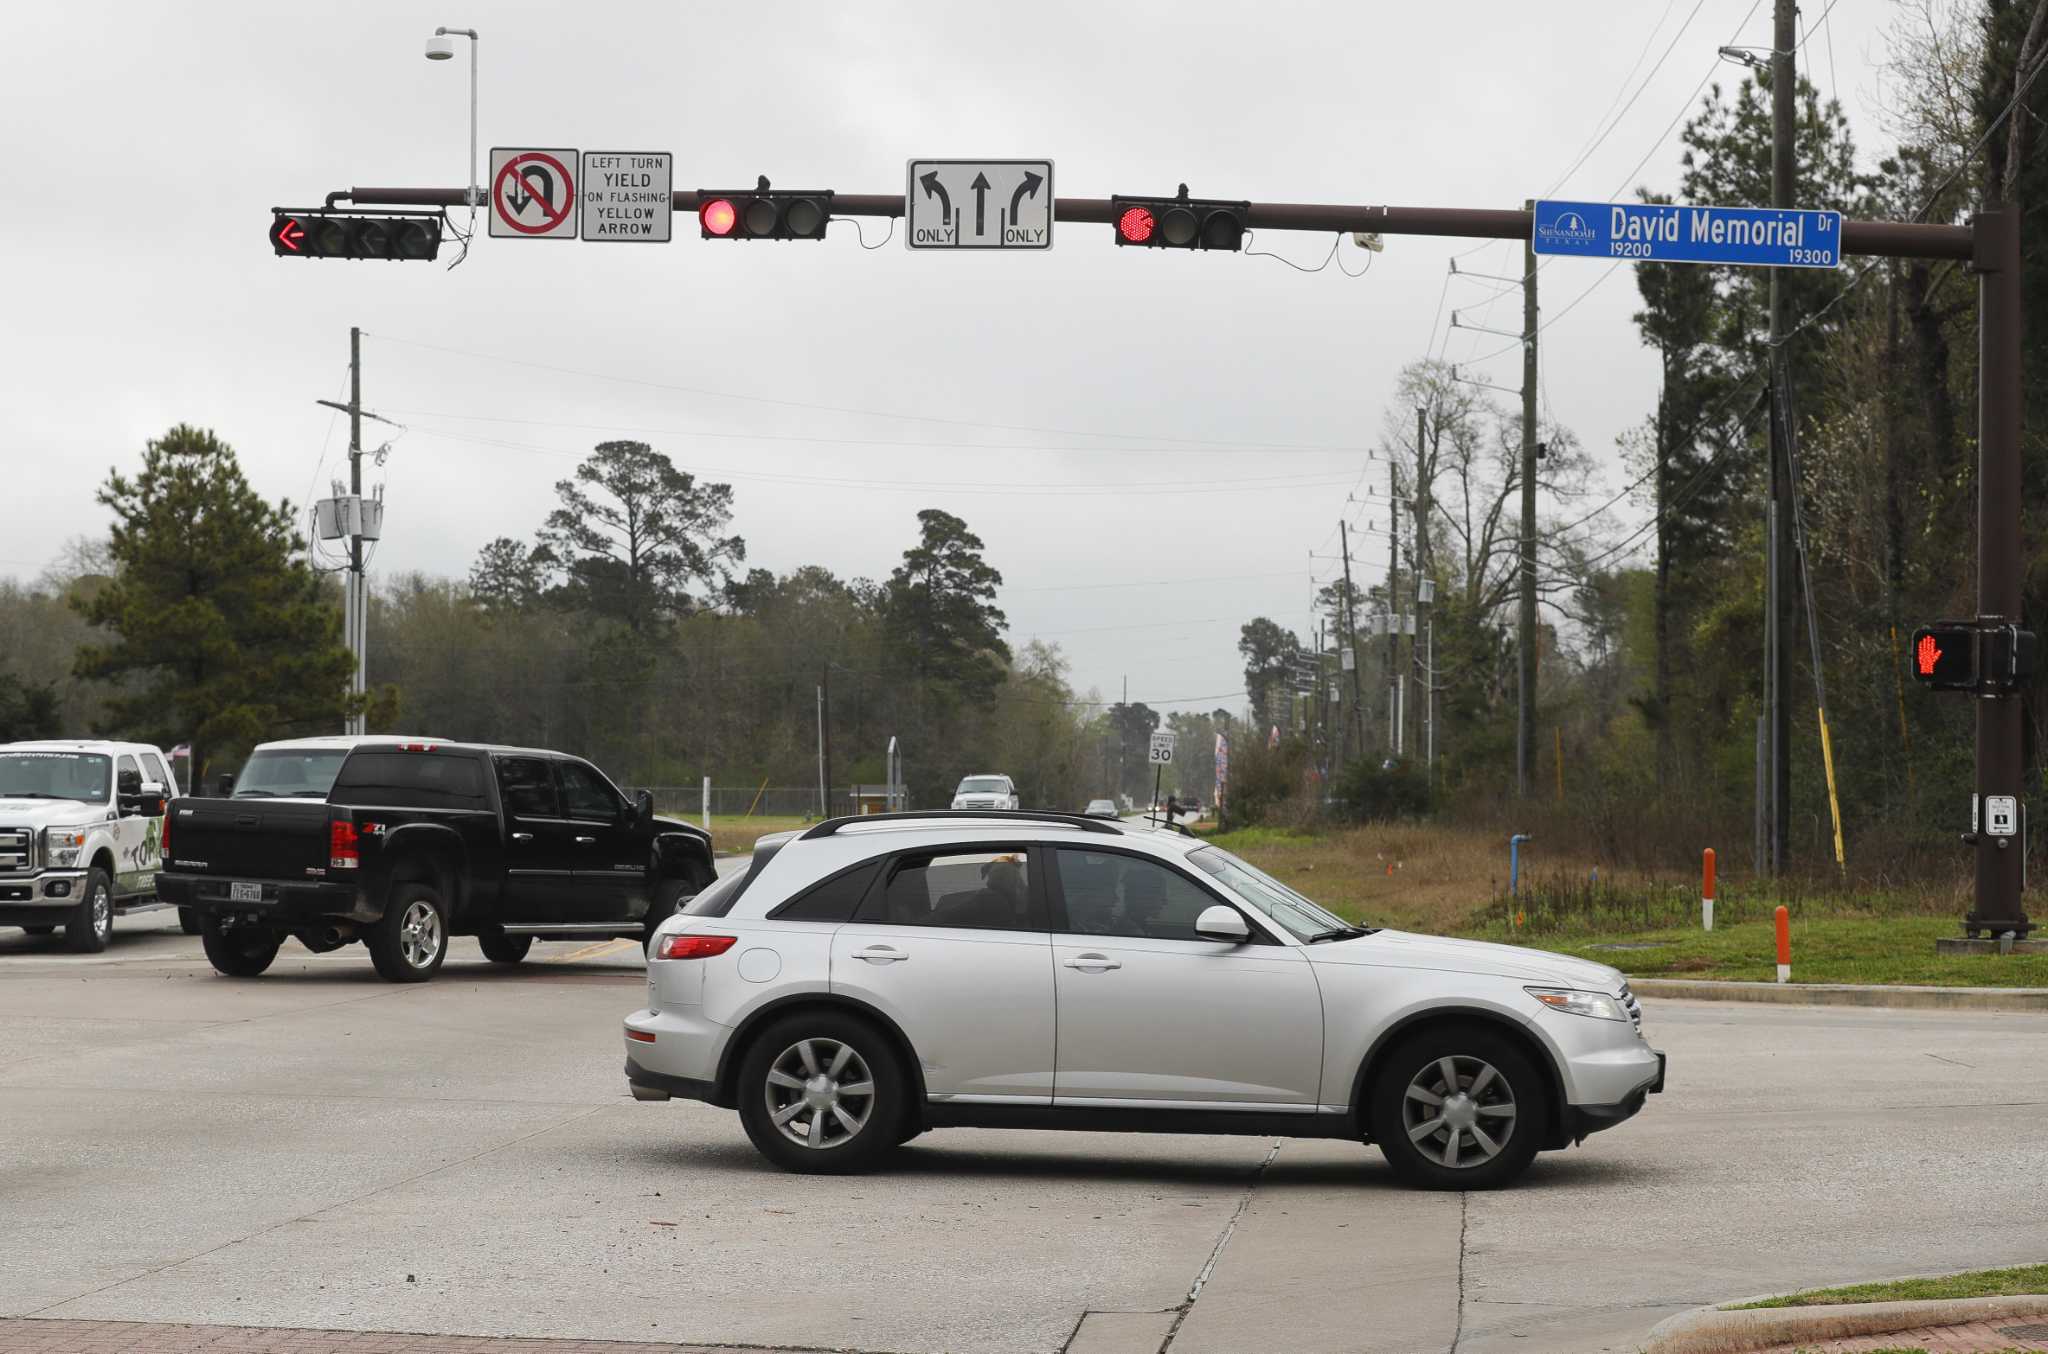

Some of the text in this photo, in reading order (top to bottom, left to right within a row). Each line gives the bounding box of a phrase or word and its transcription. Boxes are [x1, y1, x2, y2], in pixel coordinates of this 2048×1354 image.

[592, 157, 663, 168] LEFT TURN
[604, 173, 651, 187] YIELD
[588, 192, 666, 202] ON FLASHING
[597, 208, 655, 219] YELLOW
[598, 223, 652, 234] ARROW
[1538, 226, 1597, 239] SHENANDOAH
[1610, 206, 1833, 247] David Memorial Dr
[916, 229, 954, 242] ONLY
[1006, 229, 1043, 242] ONLY
[1610, 242, 1652, 257] 19200
[1789, 248, 1831, 265] 19300
[1152, 748, 1171, 761] 30
